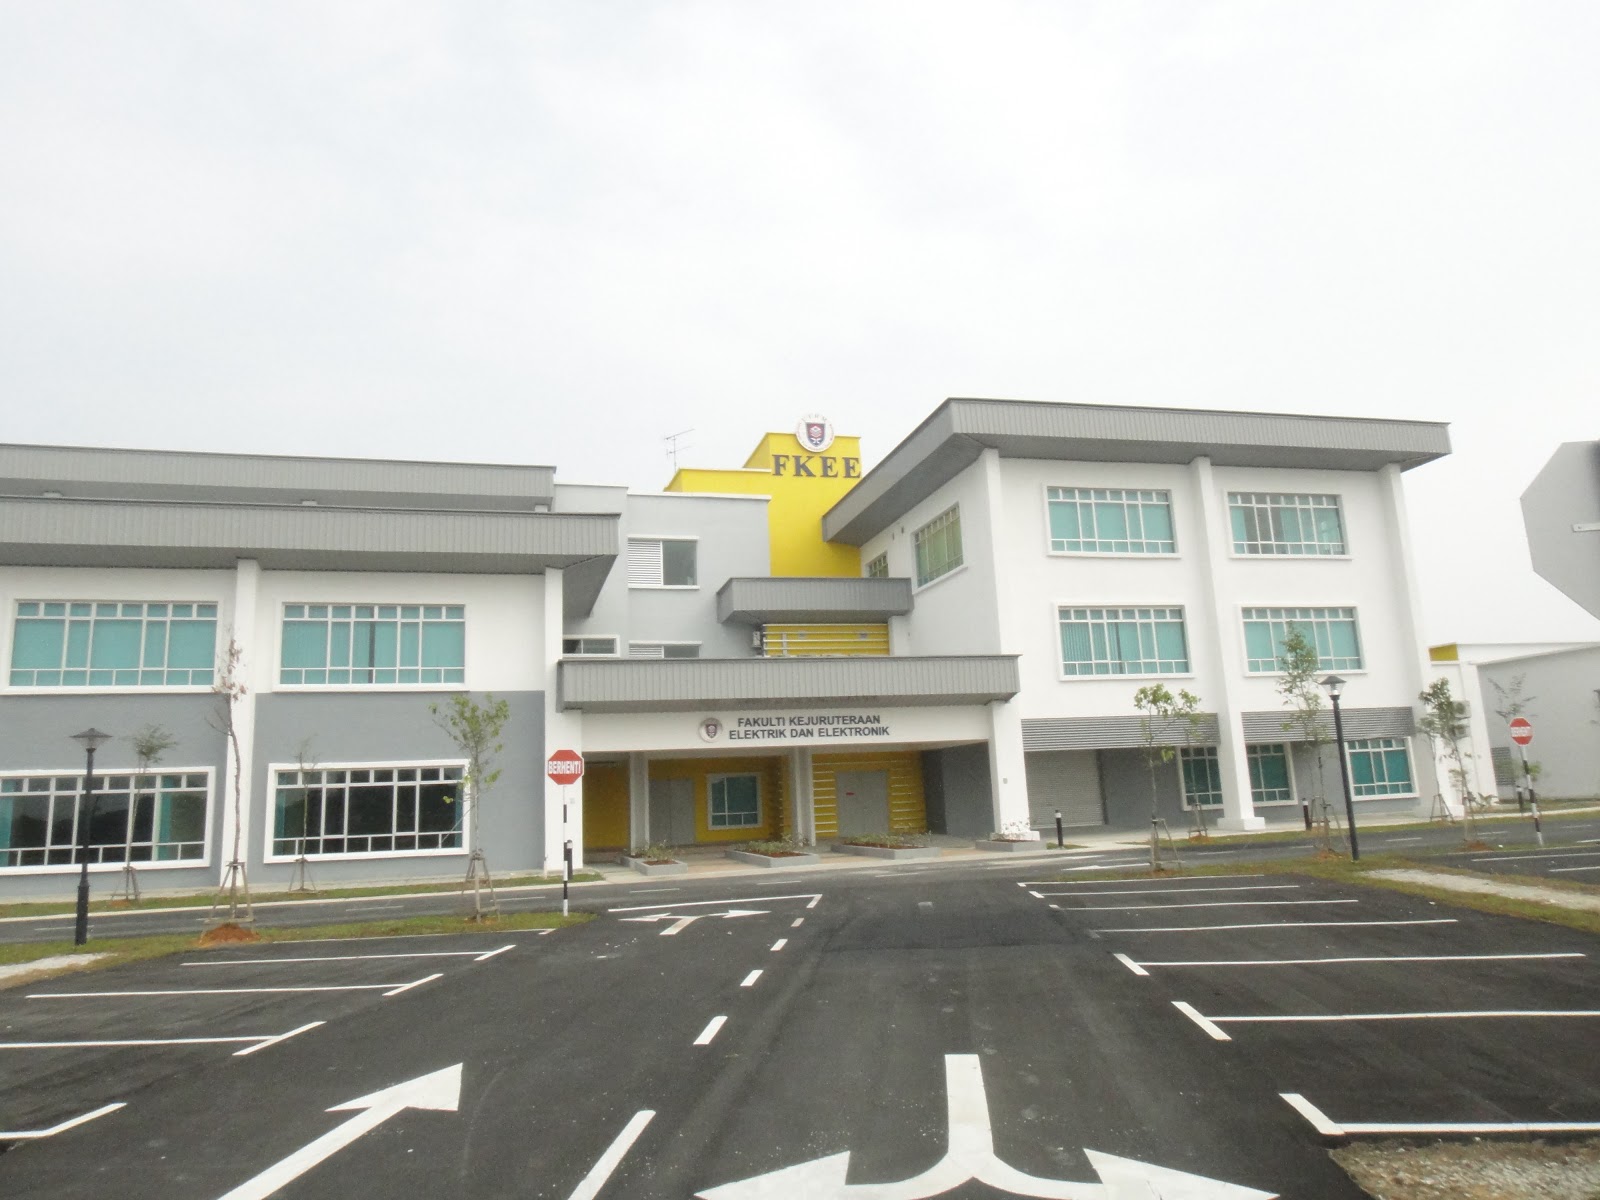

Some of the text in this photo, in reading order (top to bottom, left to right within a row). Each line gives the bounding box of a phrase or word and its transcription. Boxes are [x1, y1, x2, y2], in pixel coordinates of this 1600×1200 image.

[772, 454, 861, 478] FKEE
[738, 714, 880, 728] FAKULTI KEJURUTERAAN
[729, 726, 890, 740] ELEKTRIK DAN ELEKTRONIK
[548, 760, 582, 775] BERHENTI
